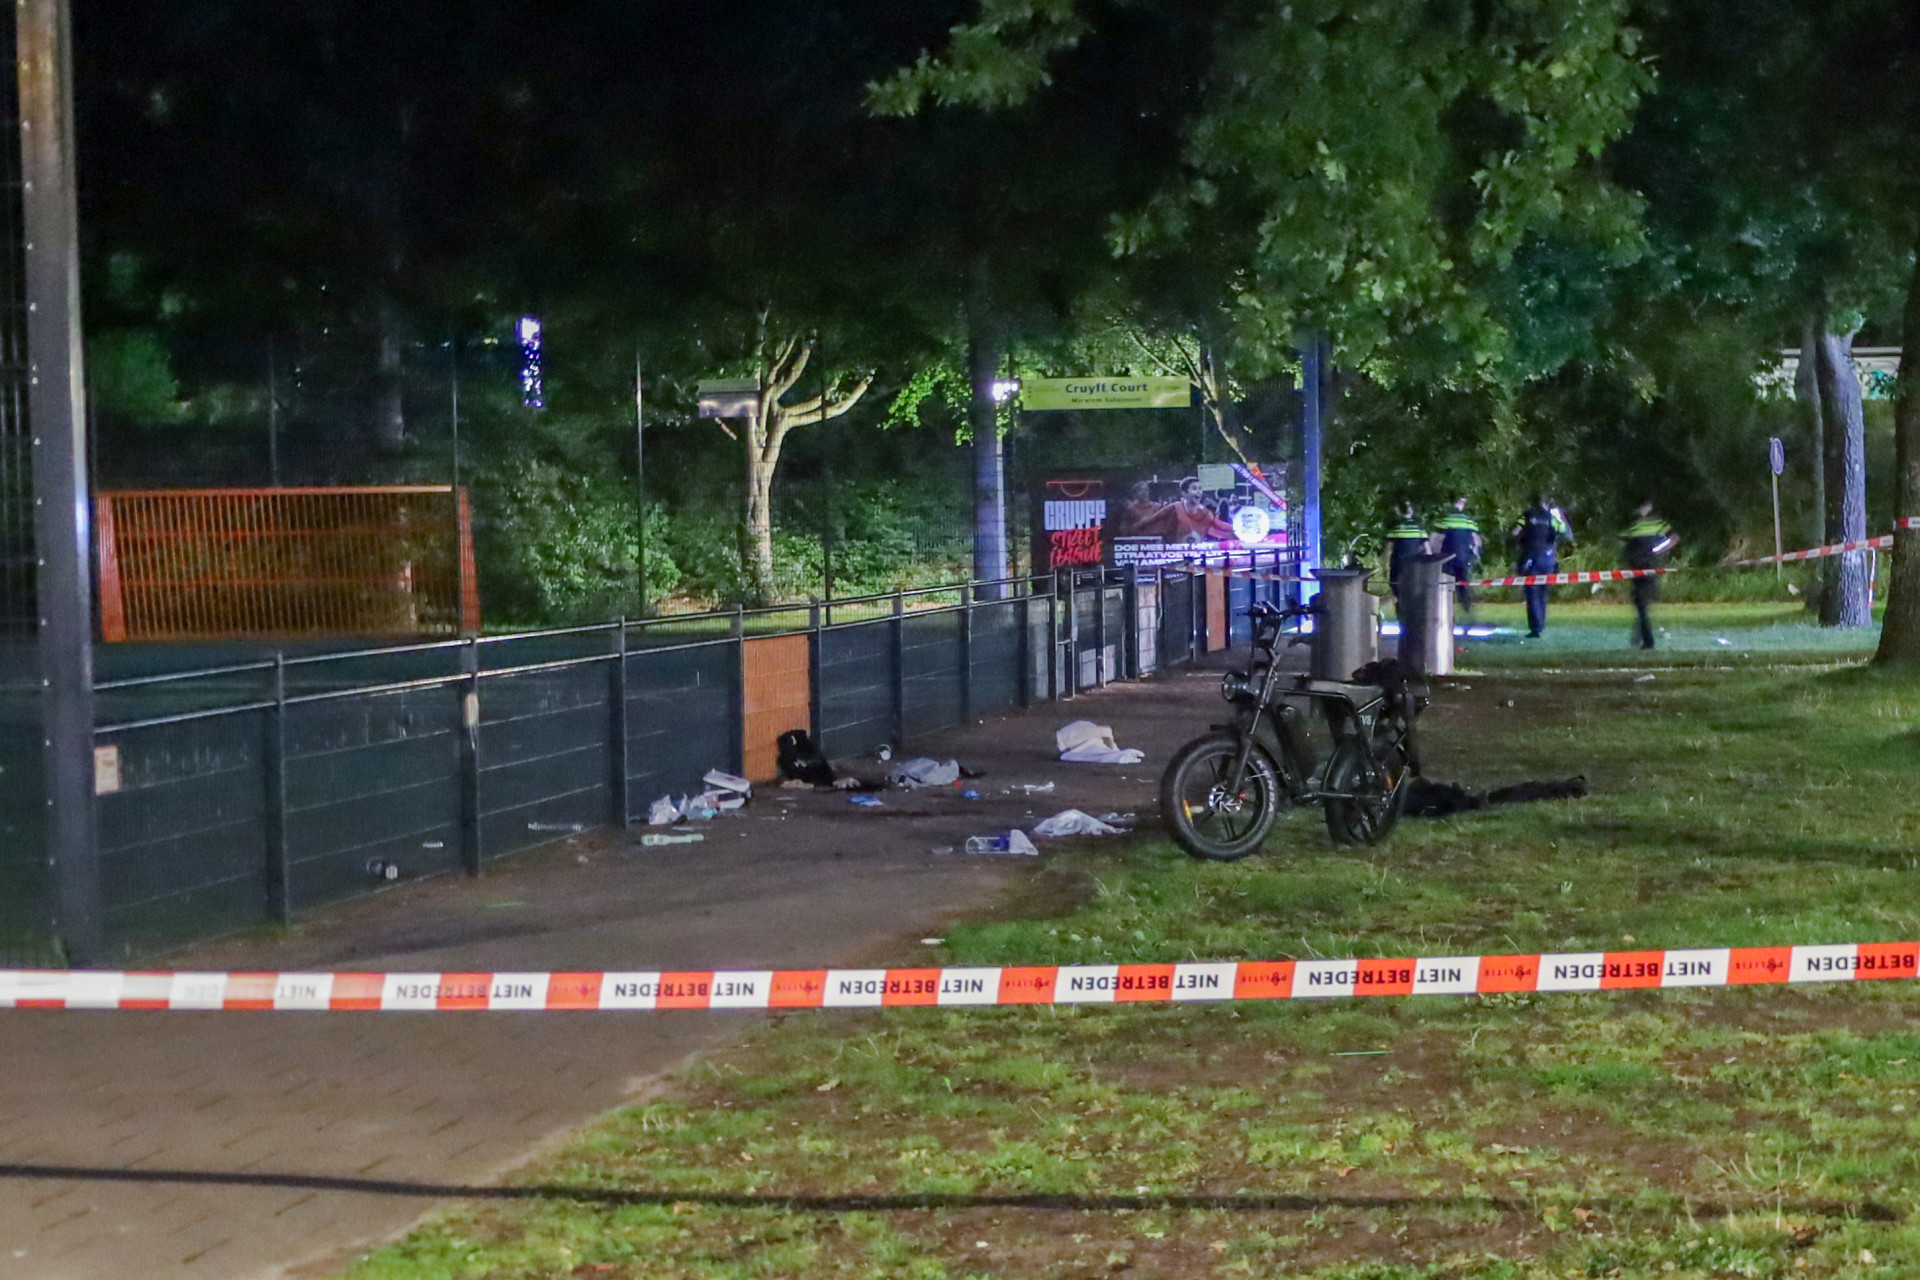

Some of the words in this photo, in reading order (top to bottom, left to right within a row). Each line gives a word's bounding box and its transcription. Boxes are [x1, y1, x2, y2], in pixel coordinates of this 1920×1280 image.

[1065, 382, 1105, 395] Cruyff
[1111, 382, 1148, 393] Court
[1044, 500, 1106, 531] CRUYFF
[1051, 526, 1104, 548] STREET
[1165, 543, 1190, 551] MET
[1666, 961, 1711, 976] NIET
[1807, 954, 1915, 971] BETREDEN
[1308, 969, 1410, 985] BETREDEN
[1417, 968, 1461, 983] NIET
[1554, 962, 1658, 979] BETREDEN
[839, 979, 936, 994] BETREDEN
[941, 979, 983, 993] NIET
[1070, 975, 1169, 990] BETREDEN
[1176, 974, 1219, 989] NIET
[396, 984, 487, 999] BETREDEN
[492, 984, 532, 998] NIET
[614, 983, 708, 998] BETREDEN
[714, 982, 754, 997] NIET
